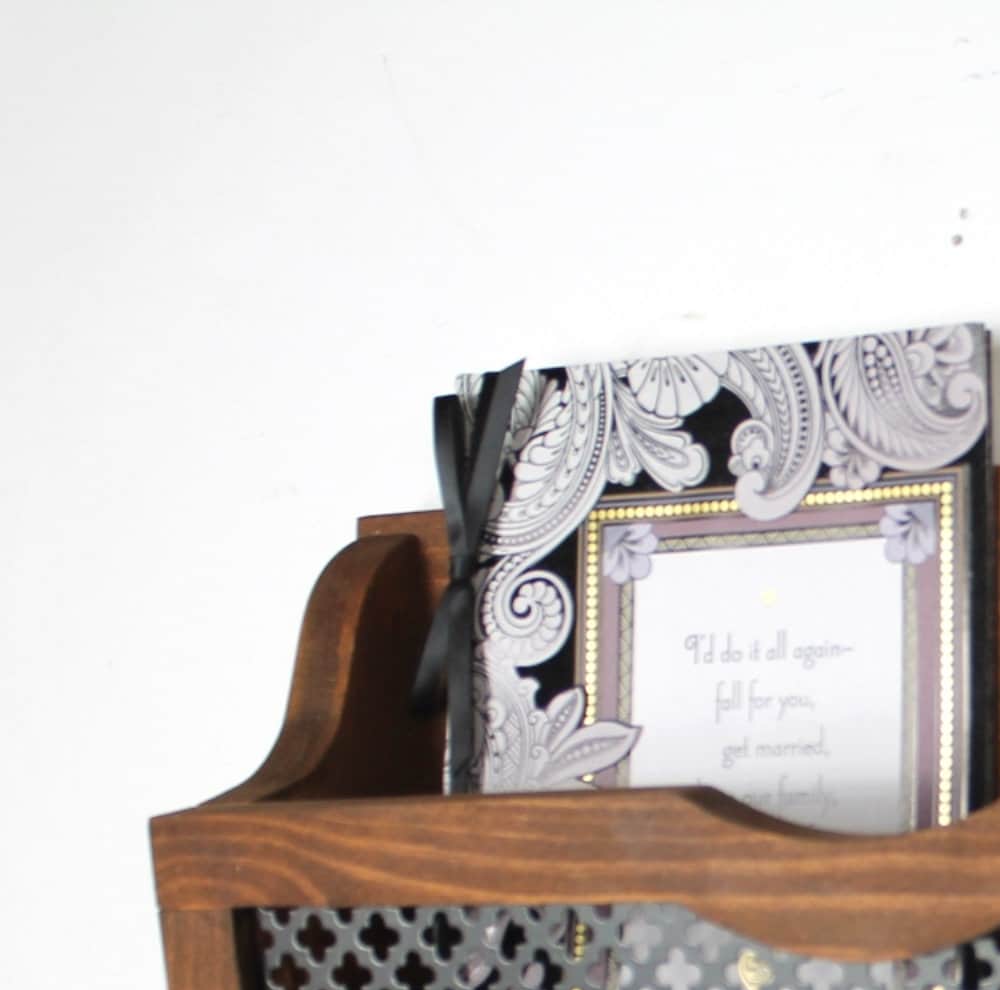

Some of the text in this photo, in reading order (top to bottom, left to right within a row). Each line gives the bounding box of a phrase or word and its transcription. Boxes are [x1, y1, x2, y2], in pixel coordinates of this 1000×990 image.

[719, 632, 744, 664] do
[749, 641, 761, 662] it
[765, 630, 788, 662] all
[714, 680, 742, 725] fall
[747, 678, 773, 723] for
[721, 738, 750, 768] get
